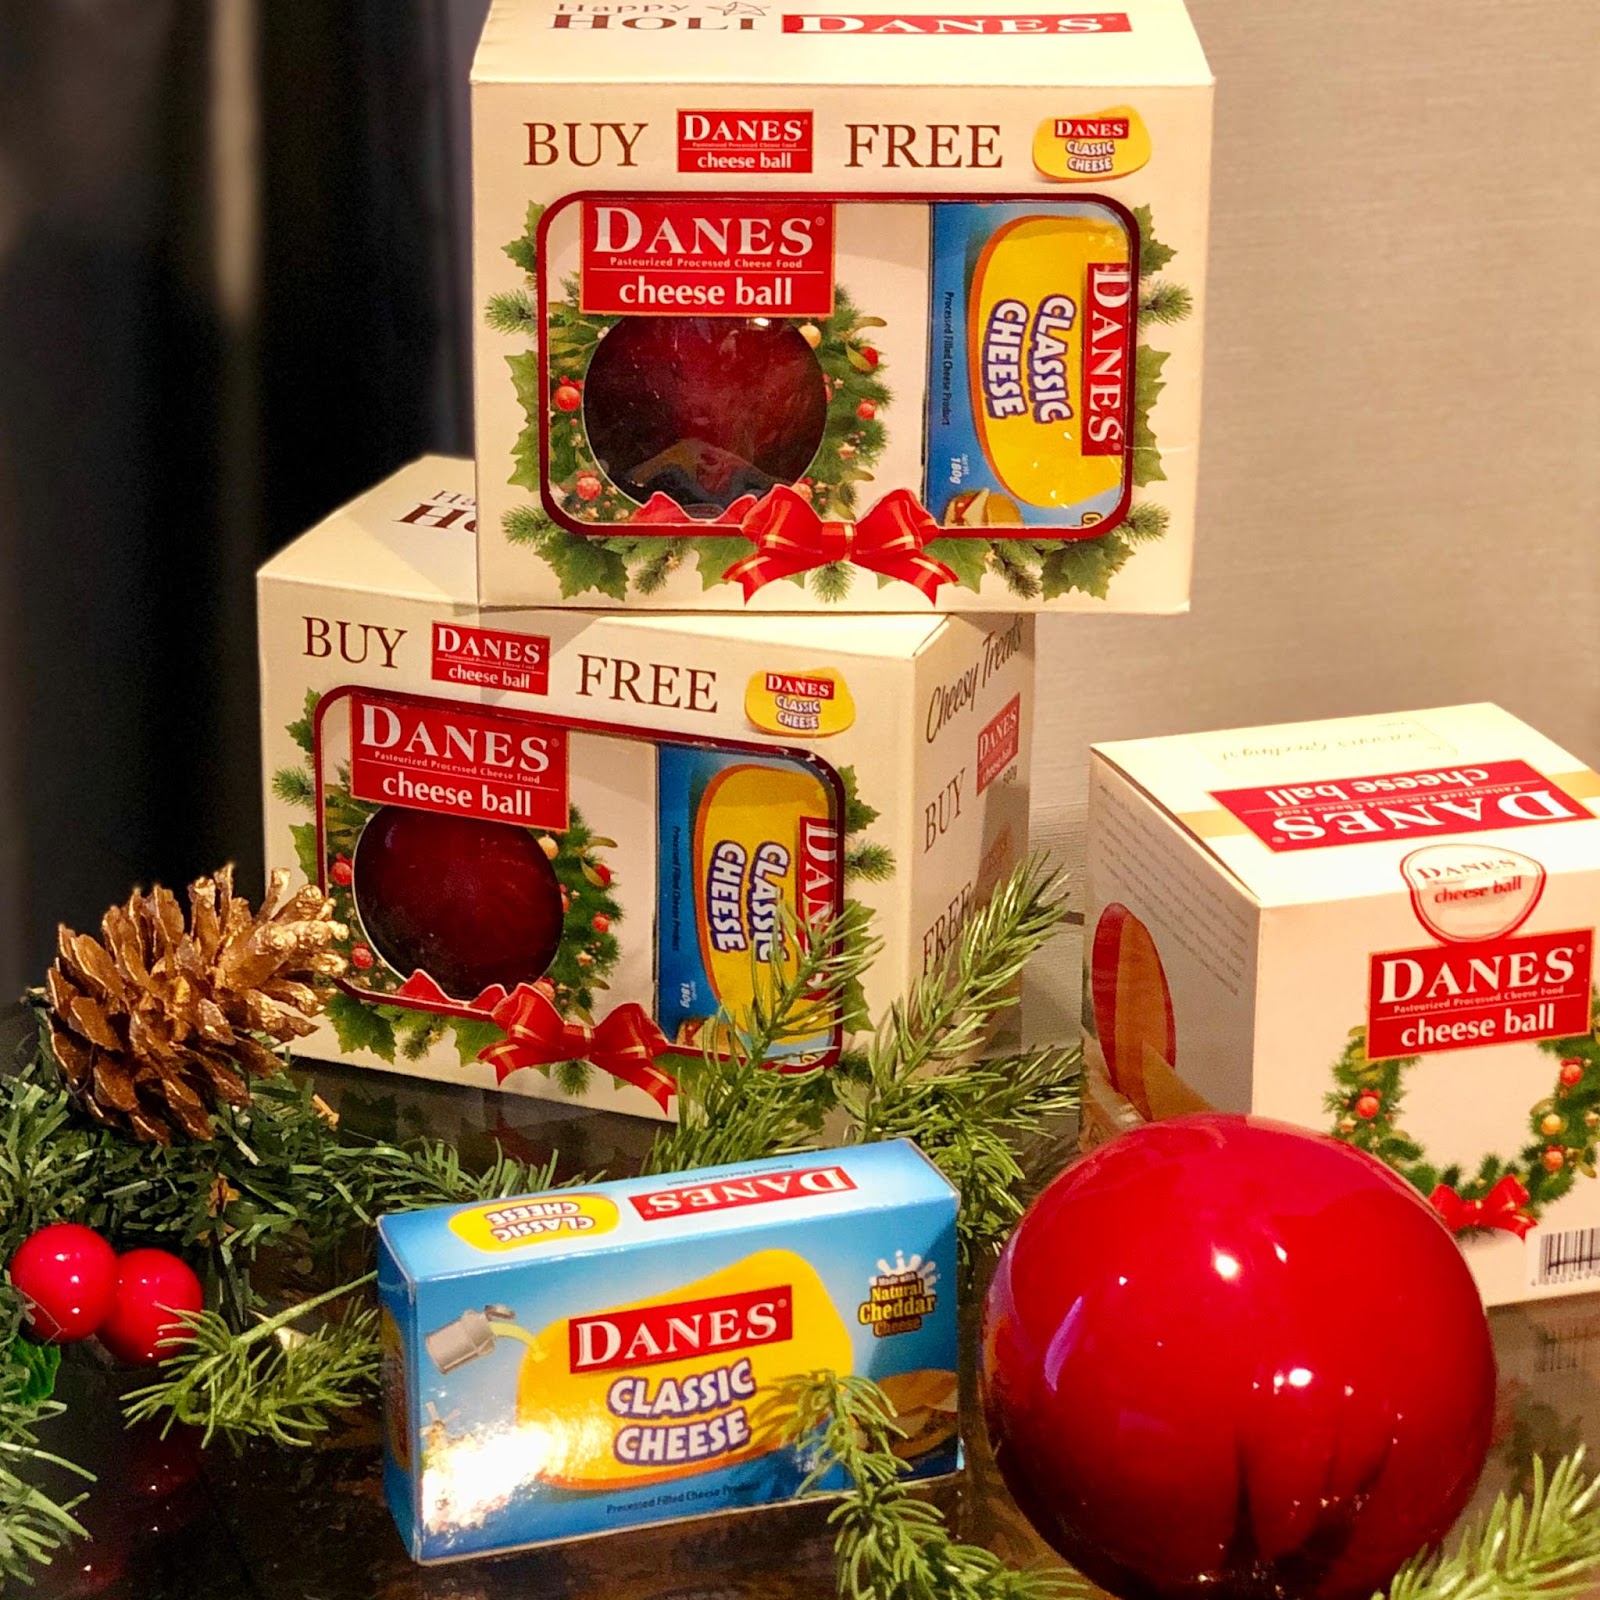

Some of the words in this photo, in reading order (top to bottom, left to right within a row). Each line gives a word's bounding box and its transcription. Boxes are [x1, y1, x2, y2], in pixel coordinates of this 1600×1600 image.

[549, 14, 758, 30] HOLI
[796, 15, 1105, 34] DANES
[555, 3, 689, 14] Happy
[683, 114, 803, 141] DANES
[1056, 120, 1124, 136] DANES
[523, 122, 648, 167] BUY
[697, 151, 756, 169] cheese
[760, 151, 792, 169] ball
[844, 124, 1003, 169] FREE
[1066, 140, 1115, 156] CLASSIC
[1067, 157, 1113, 173] CHEESE
[593, 206, 814, 257] DANES
[610, 256, 673, 267] Pasteurized
[677, 257, 731, 268] Processed
[734, 258, 773, 268] Cheese
[776, 259, 803, 269] Food
[619, 275, 726, 305] cheese
[736, 276, 792, 305] ball
[944, 291, 955, 335] Processed
[982, 299, 1029, 419] CHEESE
[1029, 294, 1077, 425] CLASSIC
[1088, 266, 1131, 443] DANES
[942, 361, 953, 391] Cheese
[302, 616, 408, 669] BUY
[437, 627, 541, 665] DANES
[448, 664, 499, 685] cheese
[502, 670, 531, 689] ball
[576, 654, 718, 714] FREE
[767, 674, 830, 698] DANES
[776, 694, 821, 715] CLASSIC
[926, 662, 979, 743] Cheesy
[776, 711, 819, 730] CHEESE
[361, 703, 550, 773] DANES
[374, 751, 428, 768] Pasteurized
[430, 758, 478, 775] Processed
[480, 767, 514, 780] Cheese
[516, 773, 541, 785] Food
[1351, 768, 1489, 794] cheese
[382, 771, 473, 808] cheese
[481, 784, 532, 817] ball
[1264, 785, 1350, 807] ball
[924, 767, 966, 854] BUY
[1272, 790, 1577, 840] DANES
[1416, 860, 1516, 879] DANES
[707, 840, 748, 953] CHEESE
[1434, 887, 1489, 903] cheese
[1493, 875, 1522, 894] ball
[923, 880, 971, 977] FREE
[1379, 946, 1575, 1004] DANES
[1393, 1000, 1450, 1014] Pasteurized
[1401, 1018, 1496, 1047] cheese
[1504, 1003, 1555, 1035] ball
[648, 1169, 850, 1212] DANES
[485, 1202, 580, 1225] CHEESE
[491, 1216, 595, 1242] CLASSIC
[871, 1279, 923, 1302] Natural
[859, 1295, 936, 1324] Cheddar
[576, 1302, 777, 1367] DANES
[607, 1358, 756, 1419] CLASSIC
[614, 1408, 751, 1466] CHEESE
[607, 1498, 654, 1514] Processed
[685, 1488, 720, 1501] Cheese
